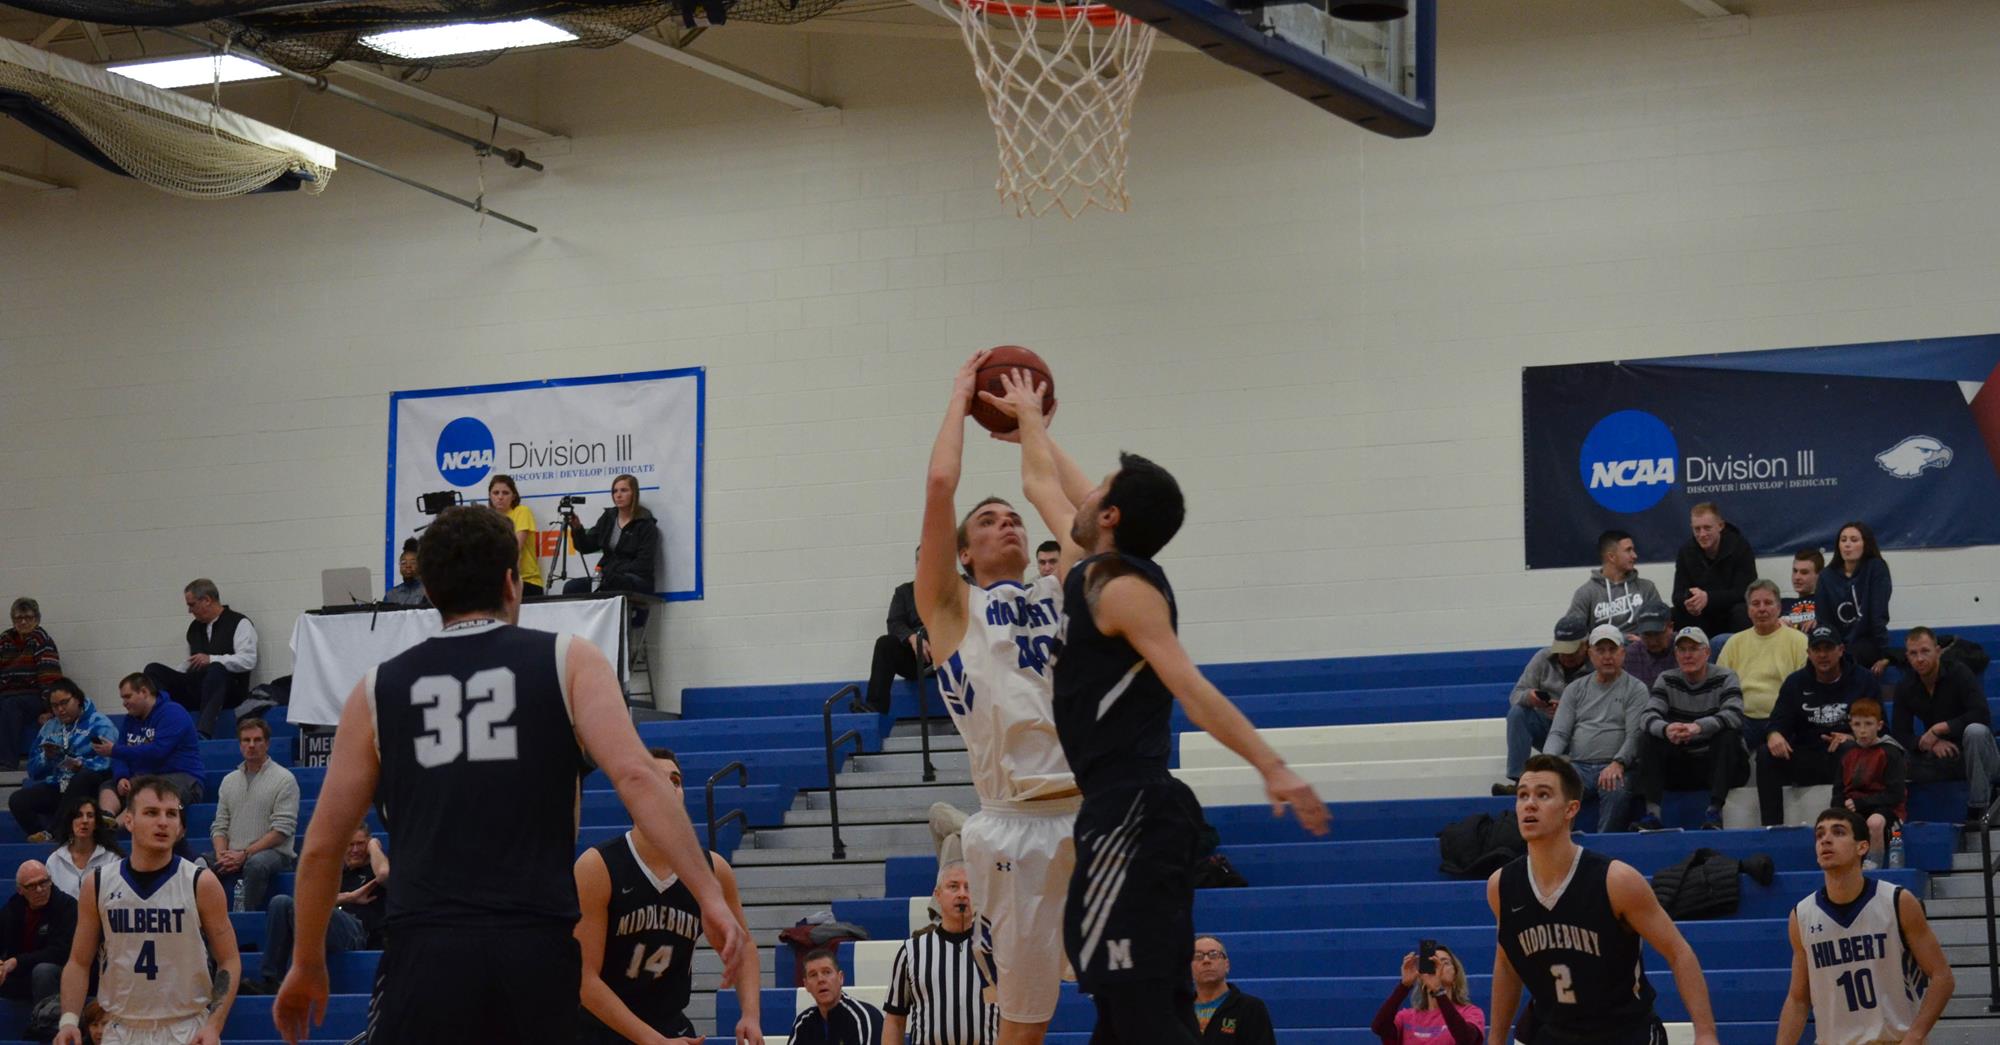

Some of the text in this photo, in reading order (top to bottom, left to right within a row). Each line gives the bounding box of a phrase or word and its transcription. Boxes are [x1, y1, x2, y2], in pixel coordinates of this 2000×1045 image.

[441, 449, 494, 471] NCAA
[509, 434, 632, 470] Division III
[1686, 449, 1815, 483] Division III
[560, 467, 603, 478] DEVELOP
[608, 463, 655, 475] DEDICATE
[1590, 457, 1676, 488] NCAA
[1686, 477, 1839, 494] DISCOVER DEVELOP DEDICATE
[410, 666, 519, 769] 32
[107, 908, 185, 934] HILBERT
[616, 904, 700, 942] MIDDLEBURY
[1106, 938, 1134, 971] M
[1517, 923, 1601, 957] MIDDLEBURY
[1811, 933, 1887, 970] HILBERT
[134, 940, 159, 981] 4
[625, 942, 674, 979] 14
[1549, 964, 1577, 1004] 2
[1836, 968, 1877, 1012] 10
